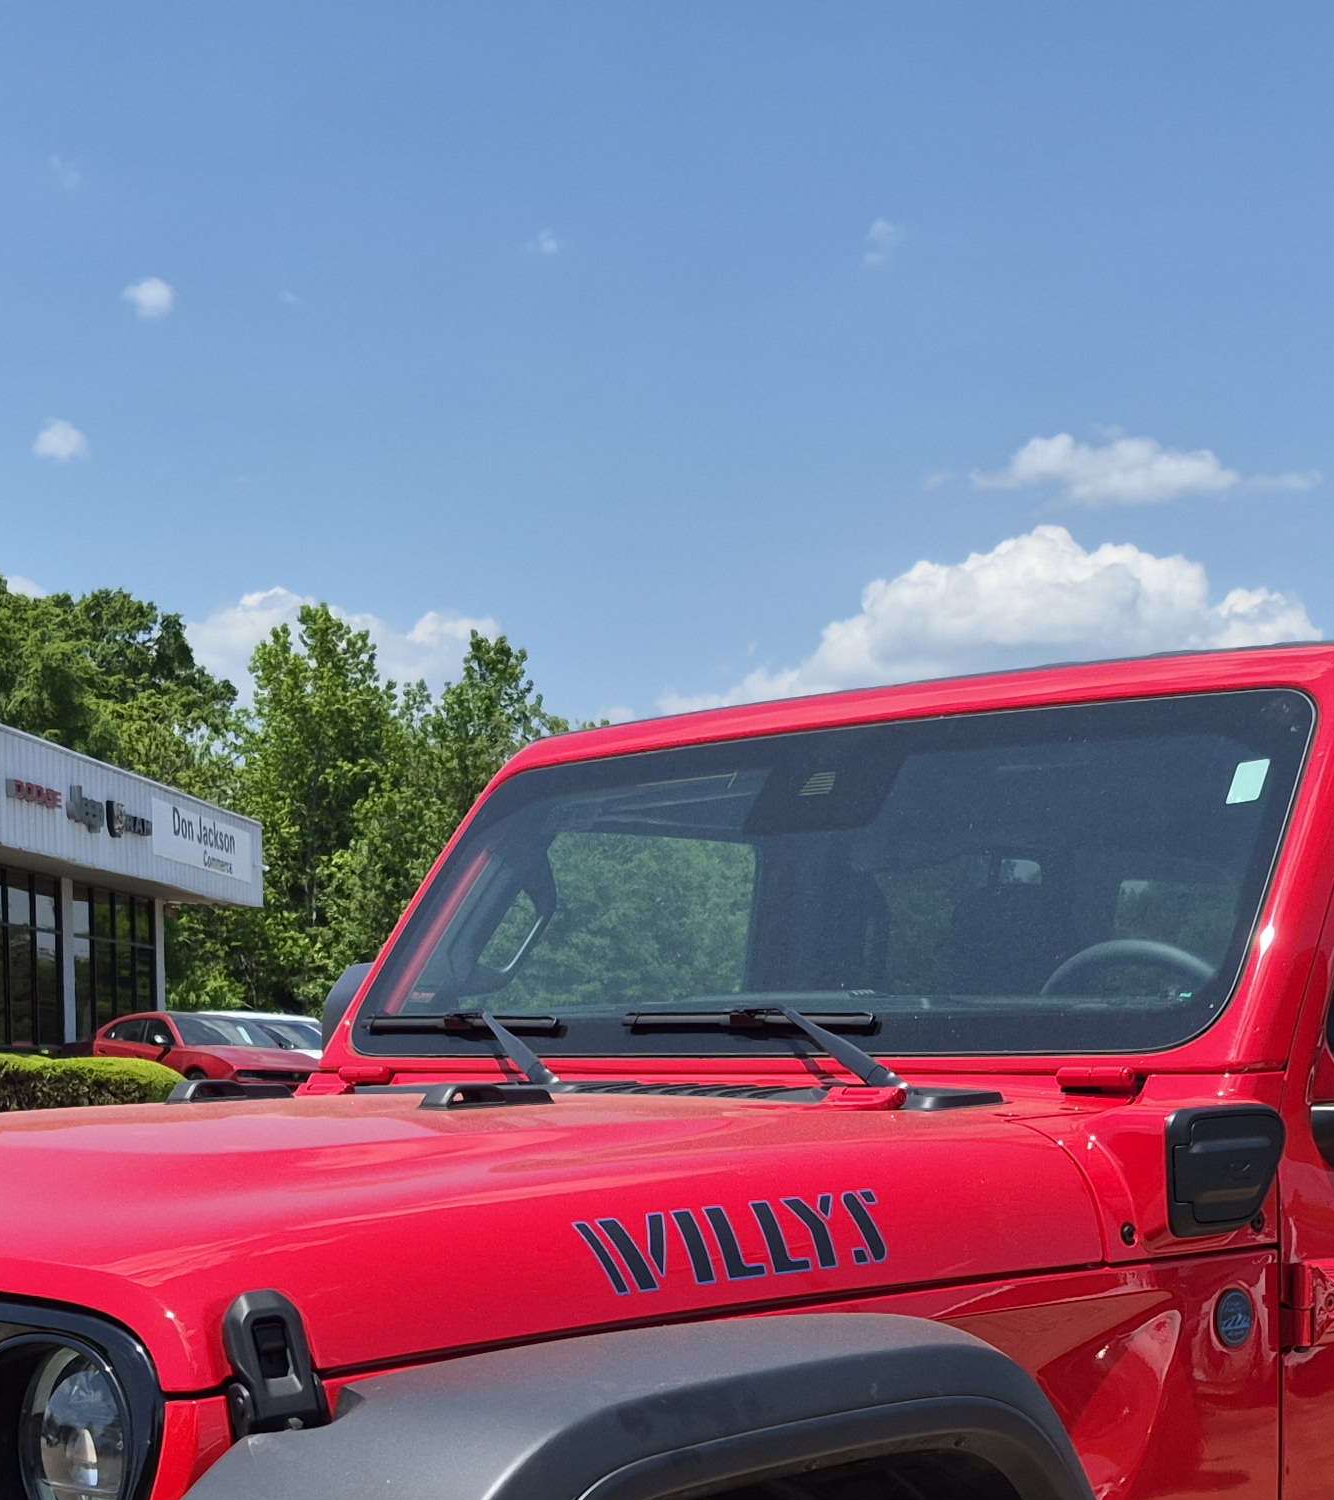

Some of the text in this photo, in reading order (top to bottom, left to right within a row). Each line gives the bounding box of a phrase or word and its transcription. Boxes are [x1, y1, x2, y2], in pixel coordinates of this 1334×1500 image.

[12, 778, 63, 810] DODGE
[125, 813, 153, 837] RAM
[172, 806, 236, 856] Don Jackson
[571, 1189, 887, 1297] WILLYS
